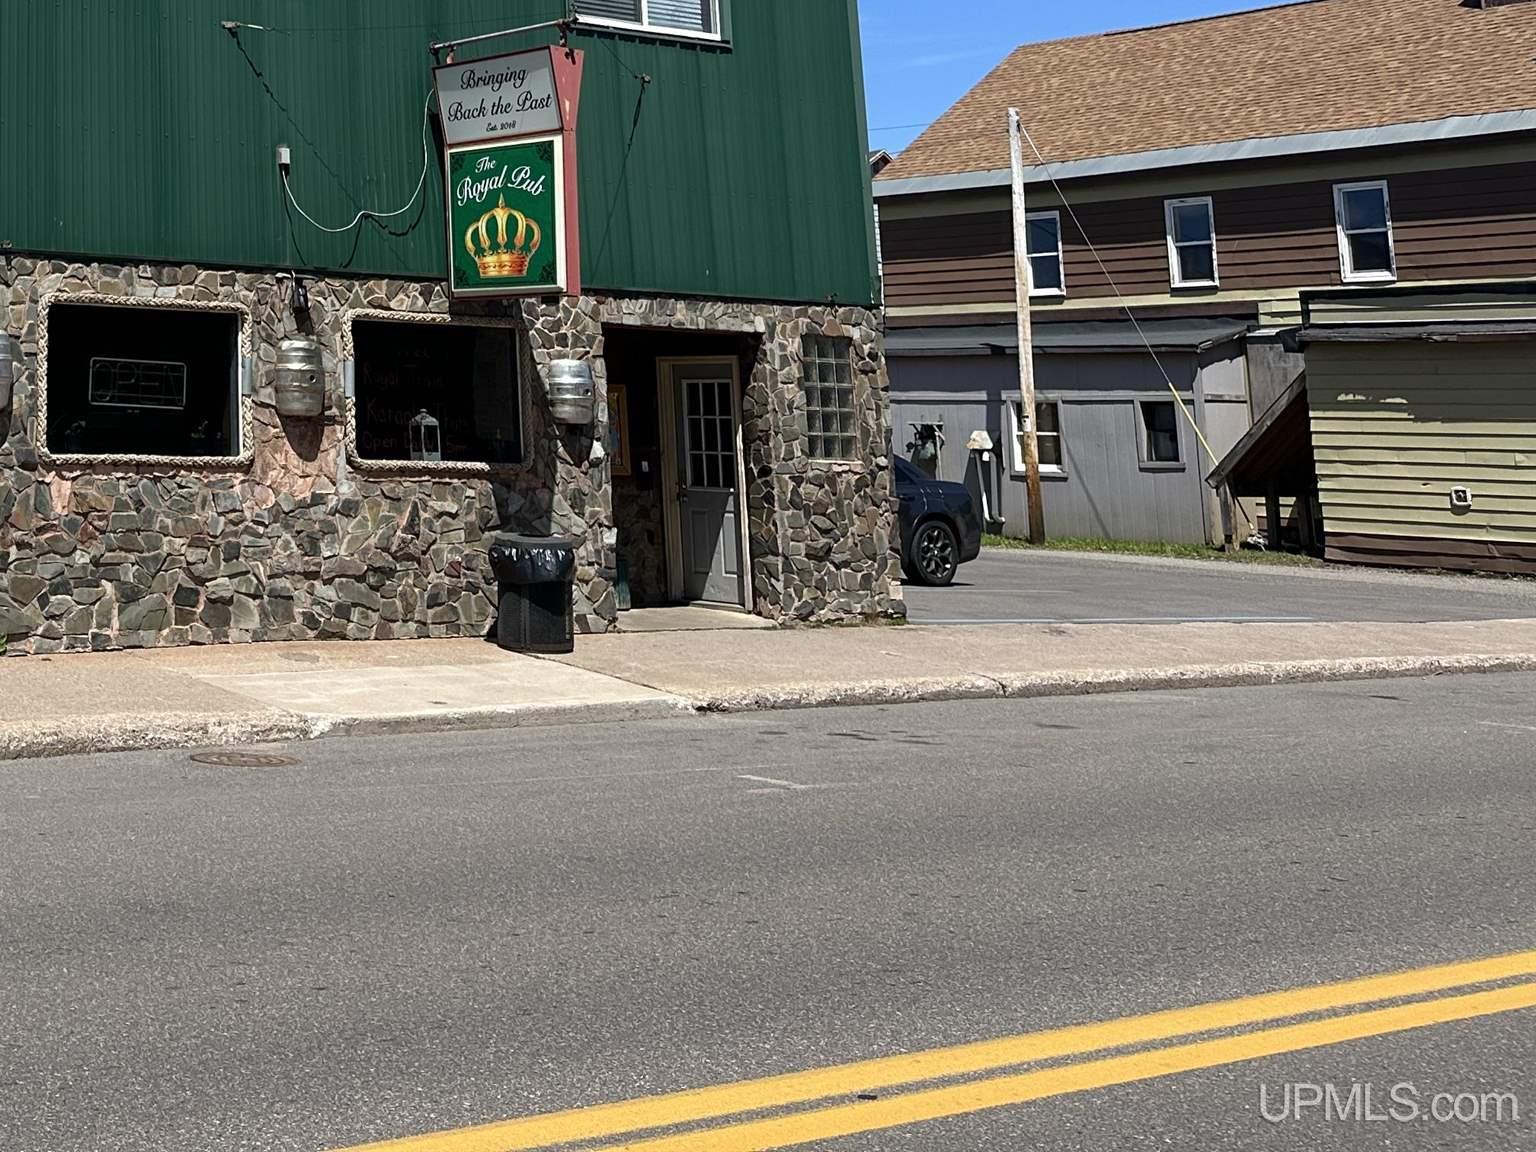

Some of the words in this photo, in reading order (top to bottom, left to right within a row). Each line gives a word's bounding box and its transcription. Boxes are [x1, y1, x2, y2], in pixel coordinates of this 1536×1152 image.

[460, 66, 527, 92] Bringing
[447, 98, 487, 122] Back
[490, 95, 512, 116] the
[515, 90, 552, 112] Past
[475, 156, 496, 173] The
[456, 164, 508, 206] Royal
[507, 165, 545, 196] Pub
[94, 361, 184, 407] OPEN
